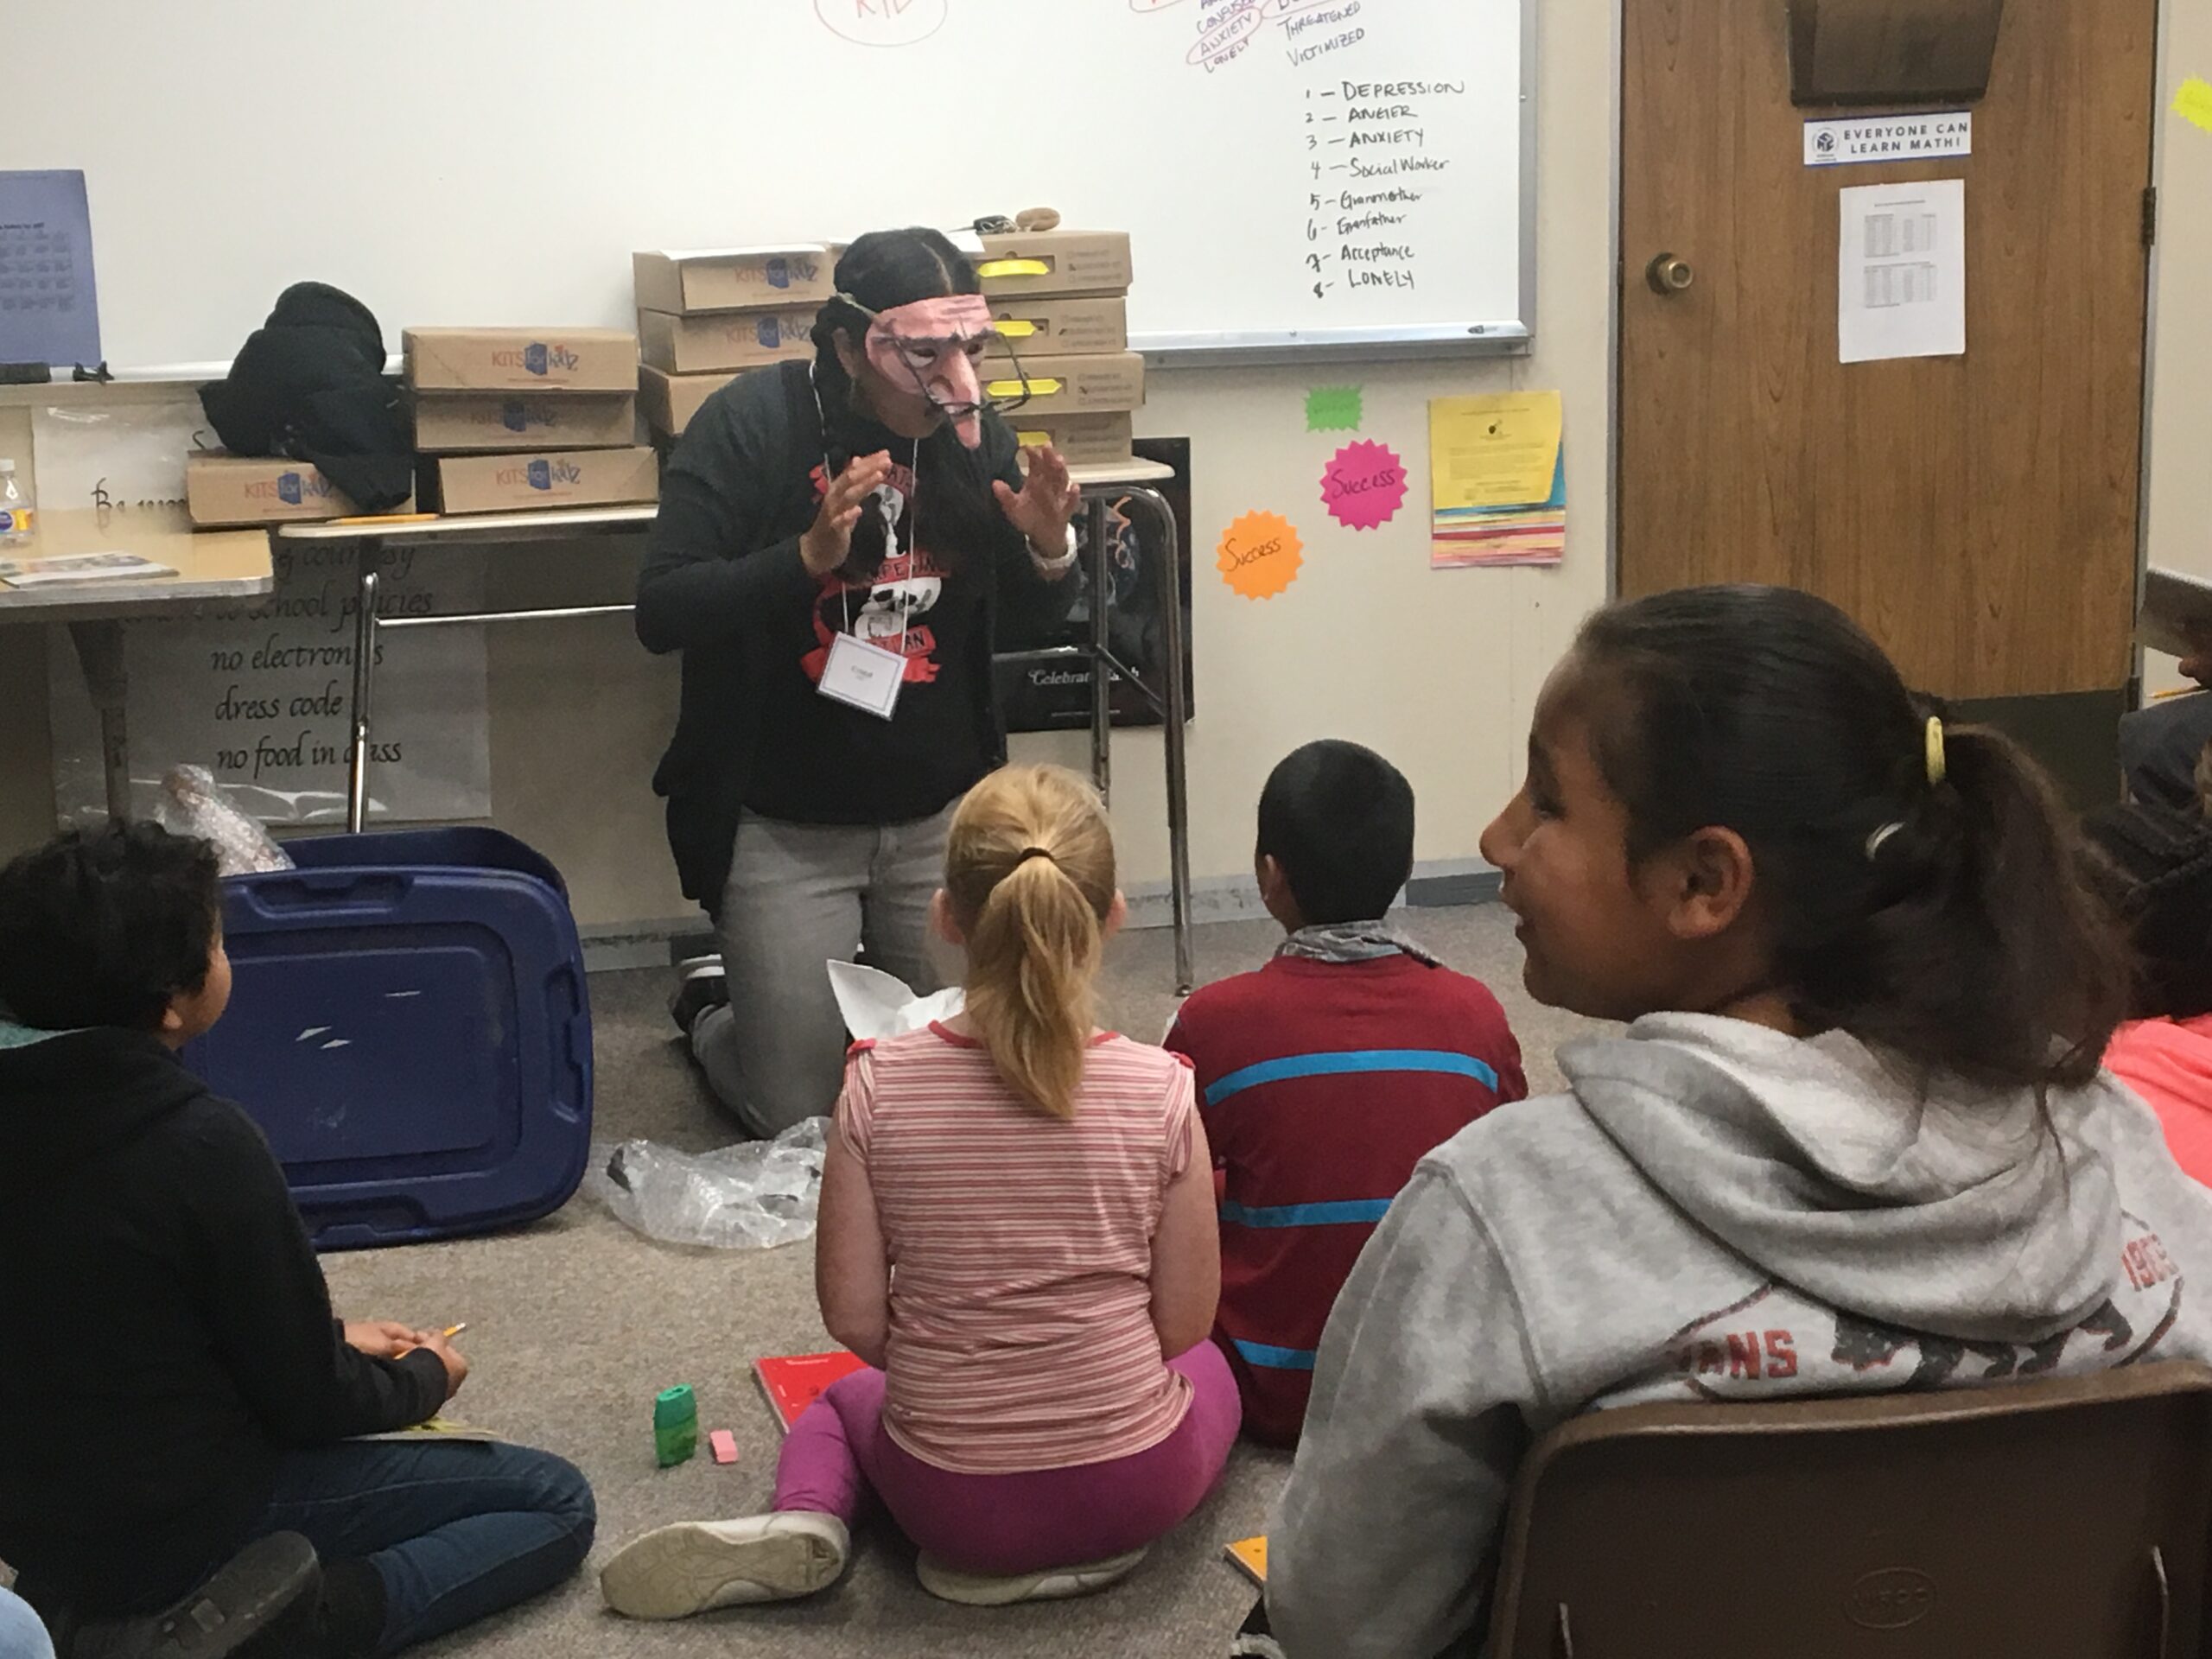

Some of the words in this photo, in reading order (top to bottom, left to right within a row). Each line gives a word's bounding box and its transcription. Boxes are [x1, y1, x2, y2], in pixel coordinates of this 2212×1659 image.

[1277, 0, 1361, 40] THREATENED
[1199, 12, 1252, 56] ANXIETY
[1203, 37, 1250, 73] LONELY
[1342, 80, 1465, 100] DEPRESSION
[1348, 105, 1419, 123] ANGER
[1349, 128, 1424, 148] ANXIETY
[1844, 125, 1928, 140] EVERYONE
[1936, 122, 1968, 134] CAN
[1851, 141, 1901, 155] LEARN
[1910, 137, 1961, 150] MATH!
[1349, 157, 1398, 178] Social
[1401, 156, 1450, 172] Worker
[1341, 242, 1415, 263] Acceptance
[1348, 269, 1415, 290] LONELY
[491, 351, 524, 367] KITS
[244, 480, 277, 499] KITS
[1332, 468, 1395, 499] Success
[1224, 537, 1282, 573] Success
[211, 650, 243, 671] no
[251, 633, 384, 670] electrons
[215, 685, 280, 721] dress
[289, 680, 343, 717] code
[218, 750, 248, 770] no
[253, 731, 311, 779] food
[312, 741, 335, 766] in
